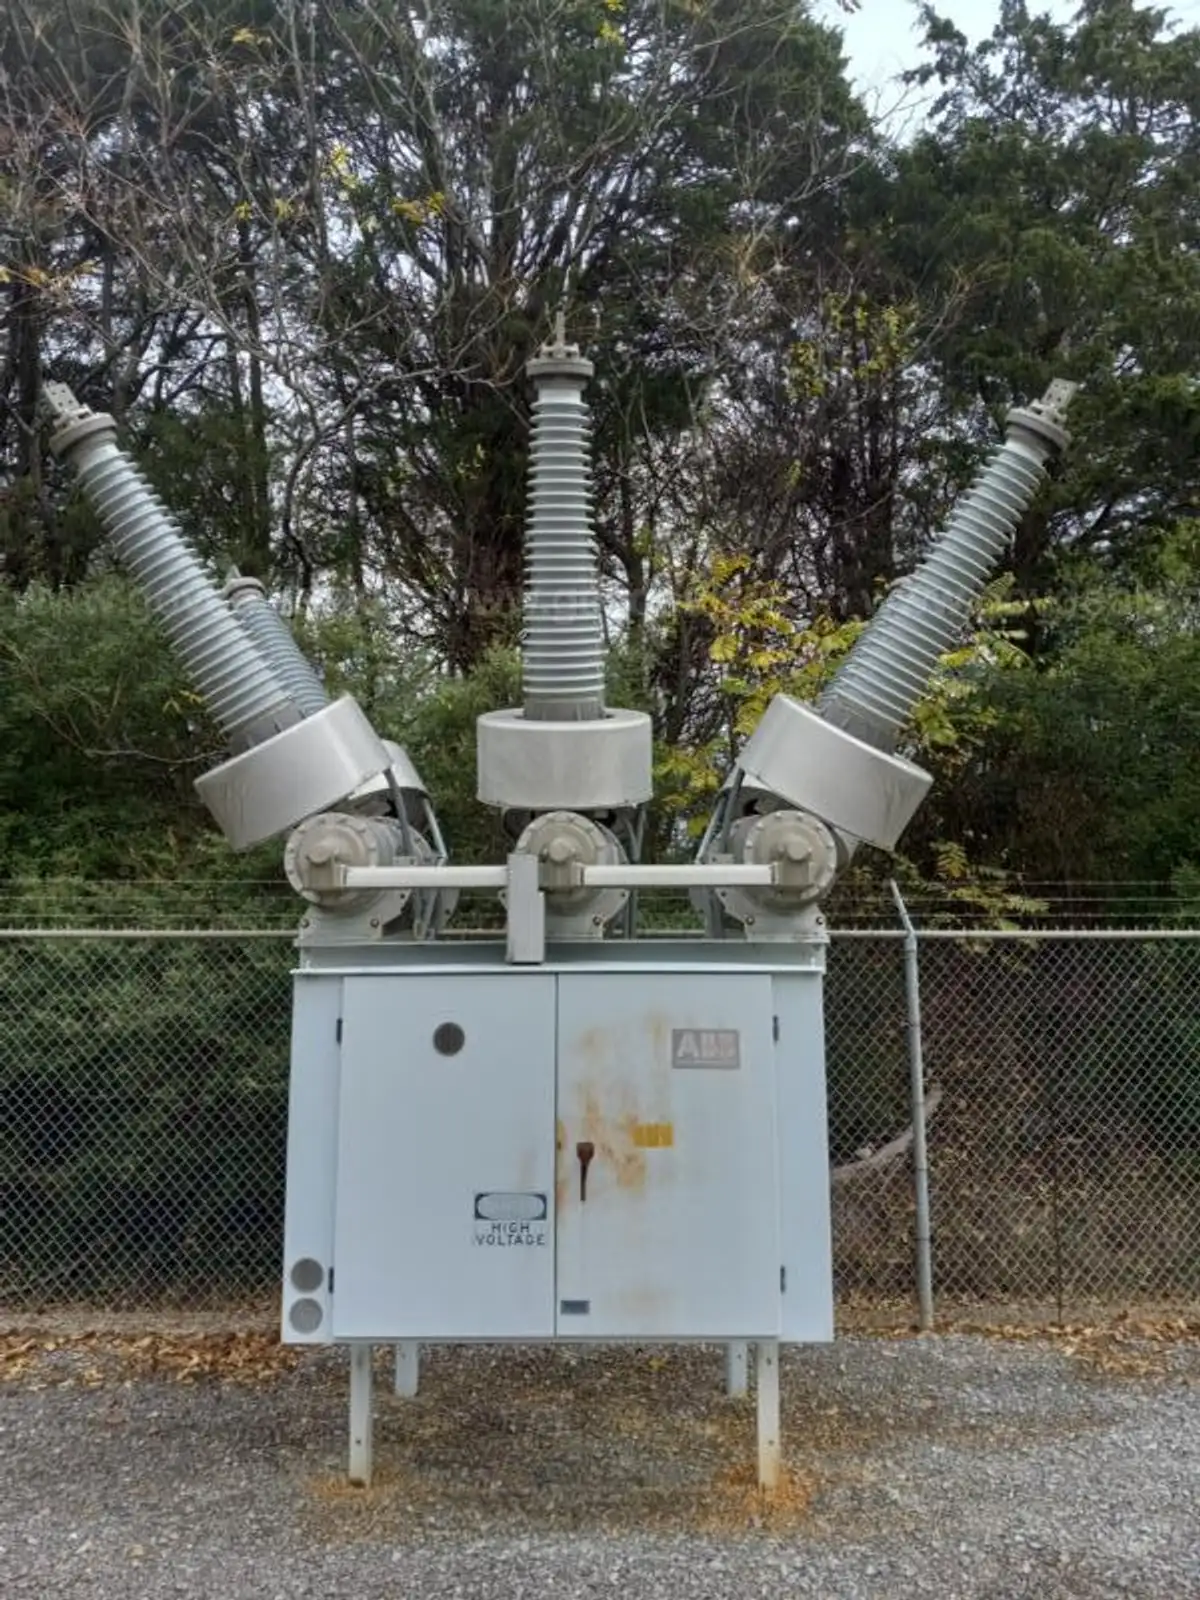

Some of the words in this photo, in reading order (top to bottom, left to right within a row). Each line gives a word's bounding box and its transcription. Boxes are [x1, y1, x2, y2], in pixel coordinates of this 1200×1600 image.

[677, 1032, 737, 1057] ABB
[492, 1222, 529, 1233] HIGH
[476, 1234, 545, 1246] VOLTAGE
